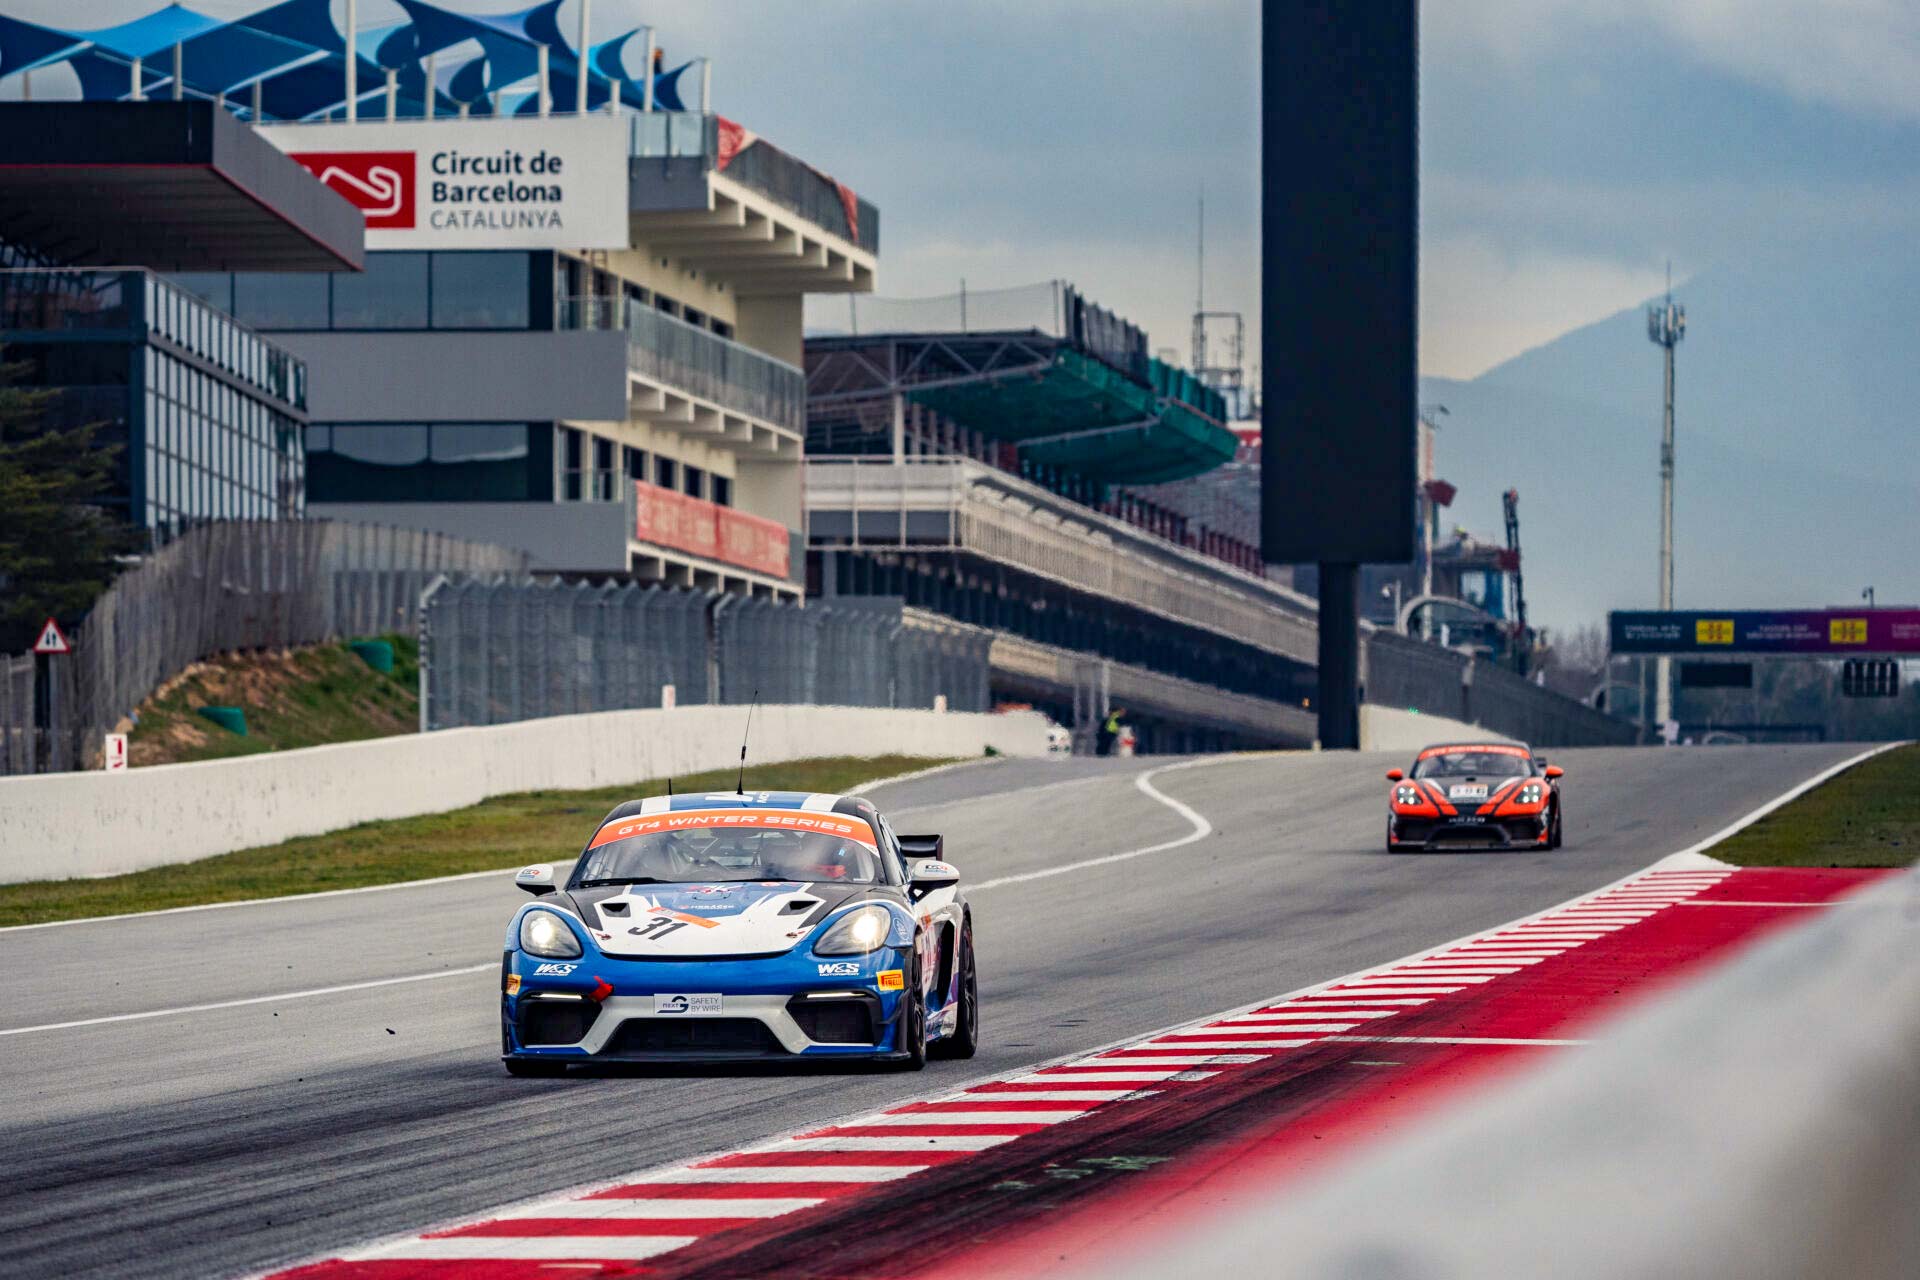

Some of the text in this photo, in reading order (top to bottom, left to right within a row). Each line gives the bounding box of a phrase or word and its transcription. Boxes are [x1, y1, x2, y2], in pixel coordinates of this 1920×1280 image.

[432, 150, 562, 175] Circuit de
[432, 180, 562, 202] Barcelona
[430, 209, 563, 229] CATALUNYA
[618, 814, 853, 835] GT4 WINTER SERIES
[628, 917, 688, 940] 31
[818, 962, 860, 973] W&S
[702, 1004, 721, 1012] WIRE
